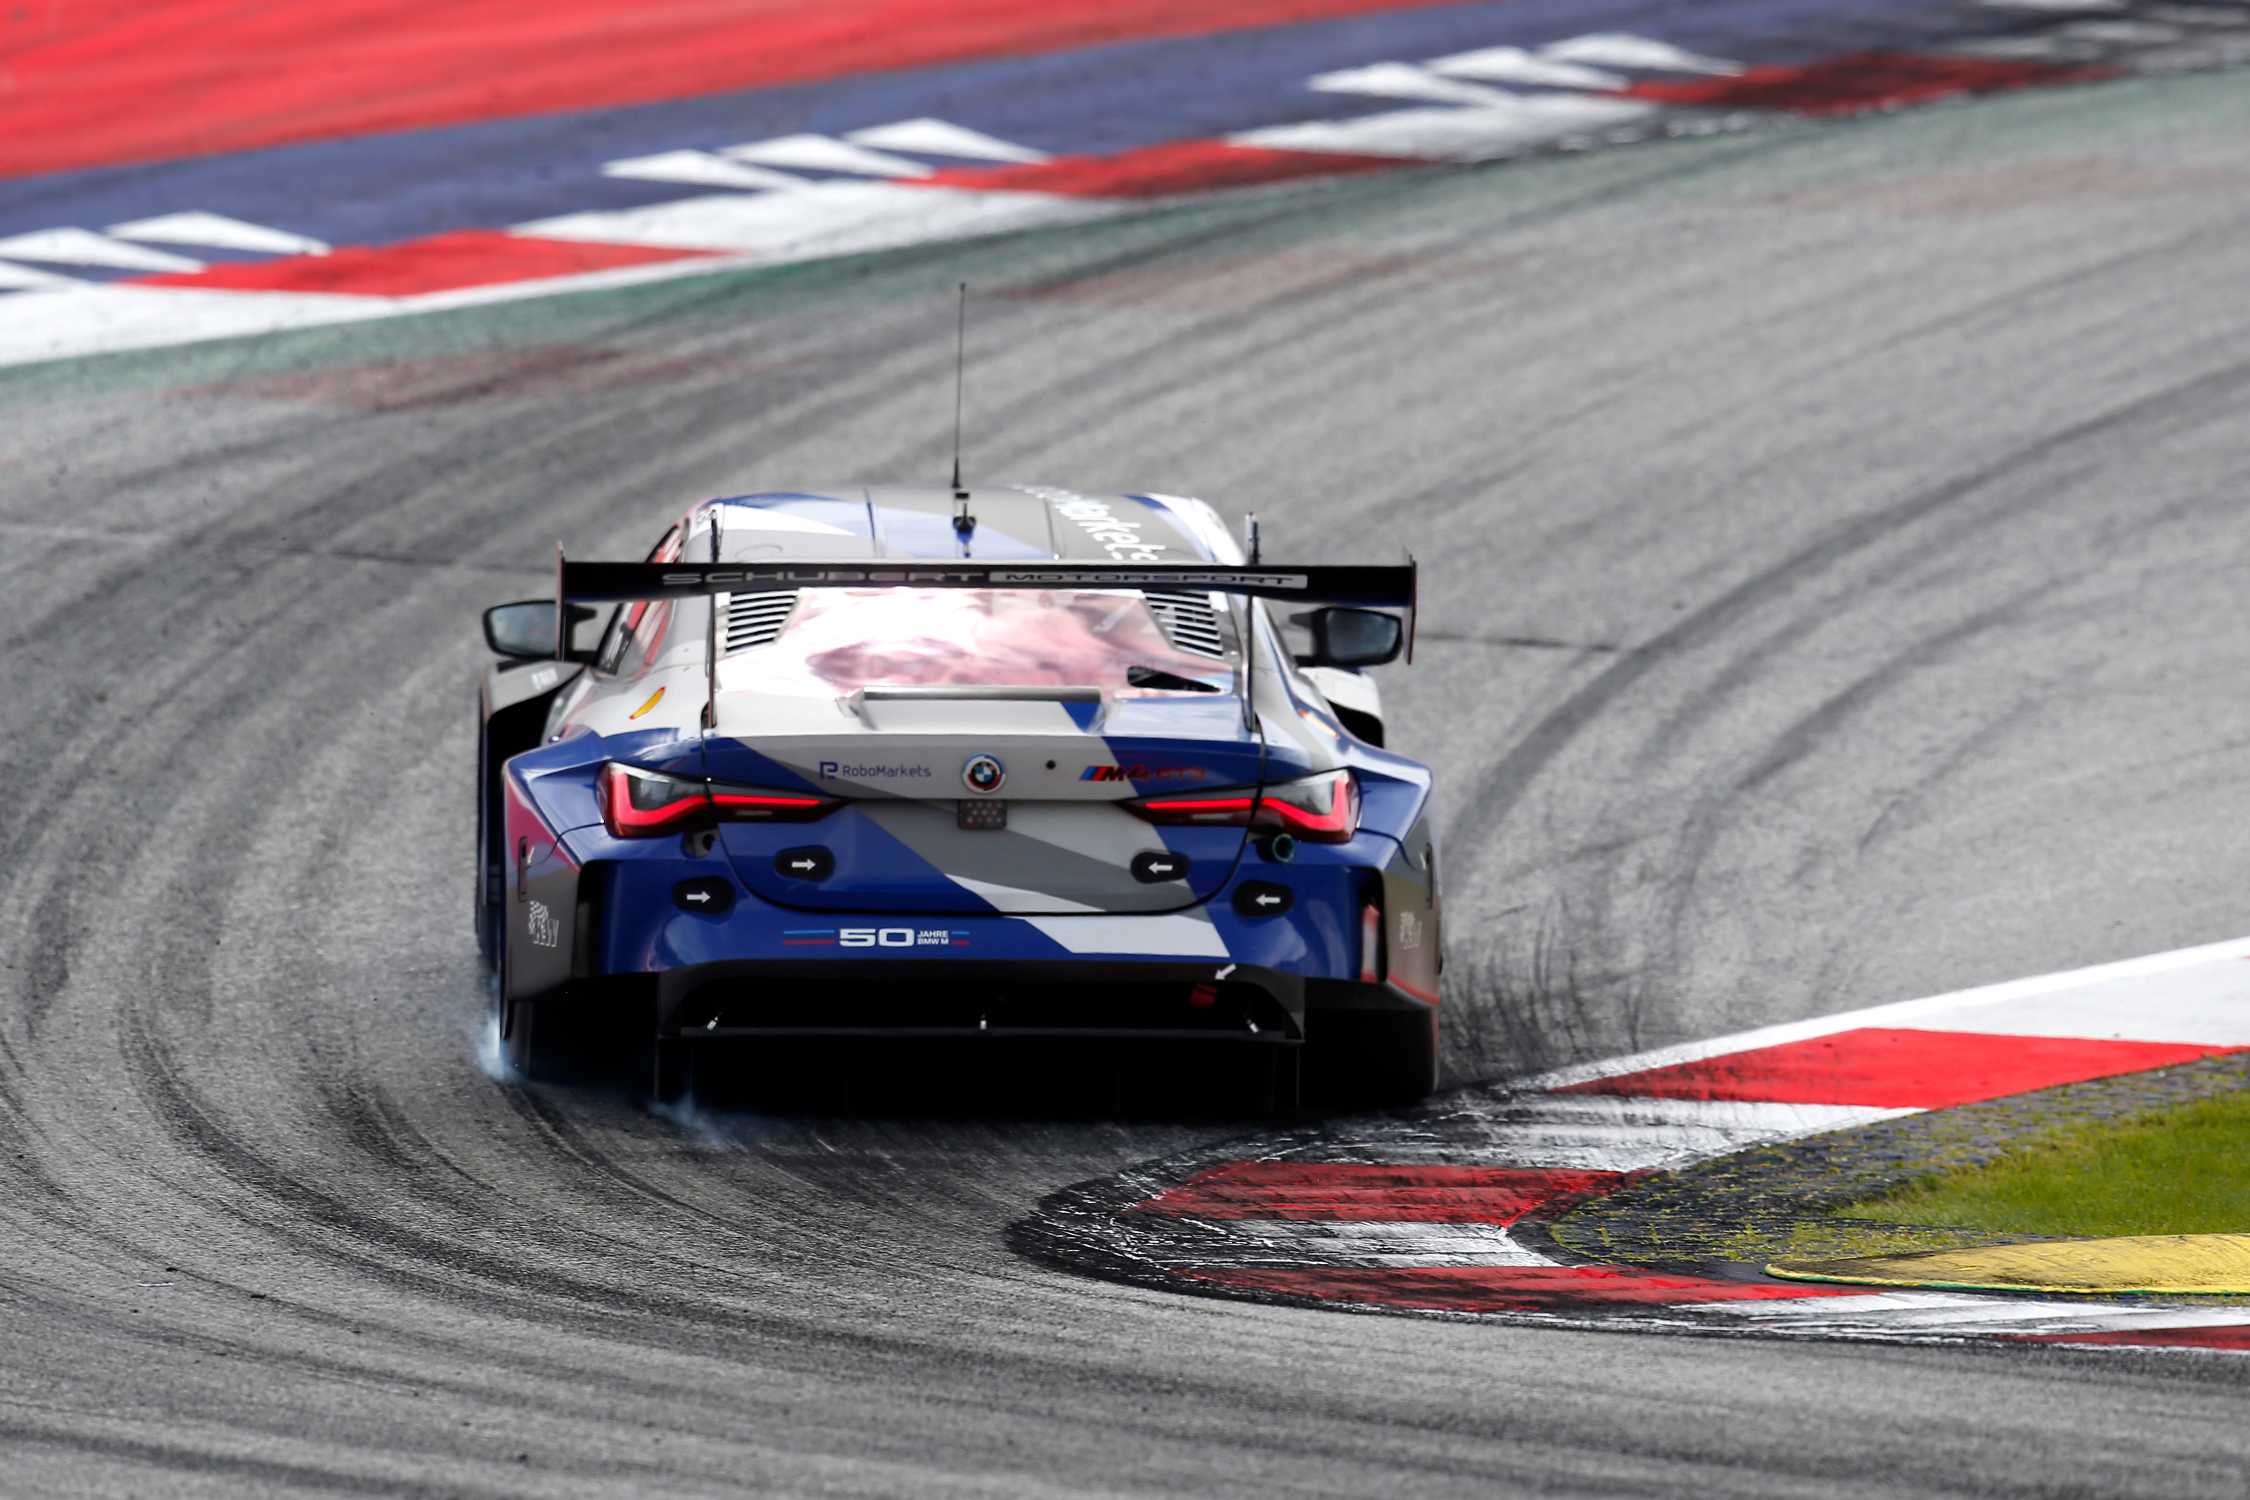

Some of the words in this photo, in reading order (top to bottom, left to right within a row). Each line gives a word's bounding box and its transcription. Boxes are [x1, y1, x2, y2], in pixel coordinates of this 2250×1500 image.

[1005, 573, 1294, 585] MOTORSPORT
[842, 763, 932, 778] RoboMarkets
[840, 928, 915, 947] 50
[918, 929, 949, 938] JAHRE
[917, 937, 939, 945] BMW
[940, 937, 949, 945] M
